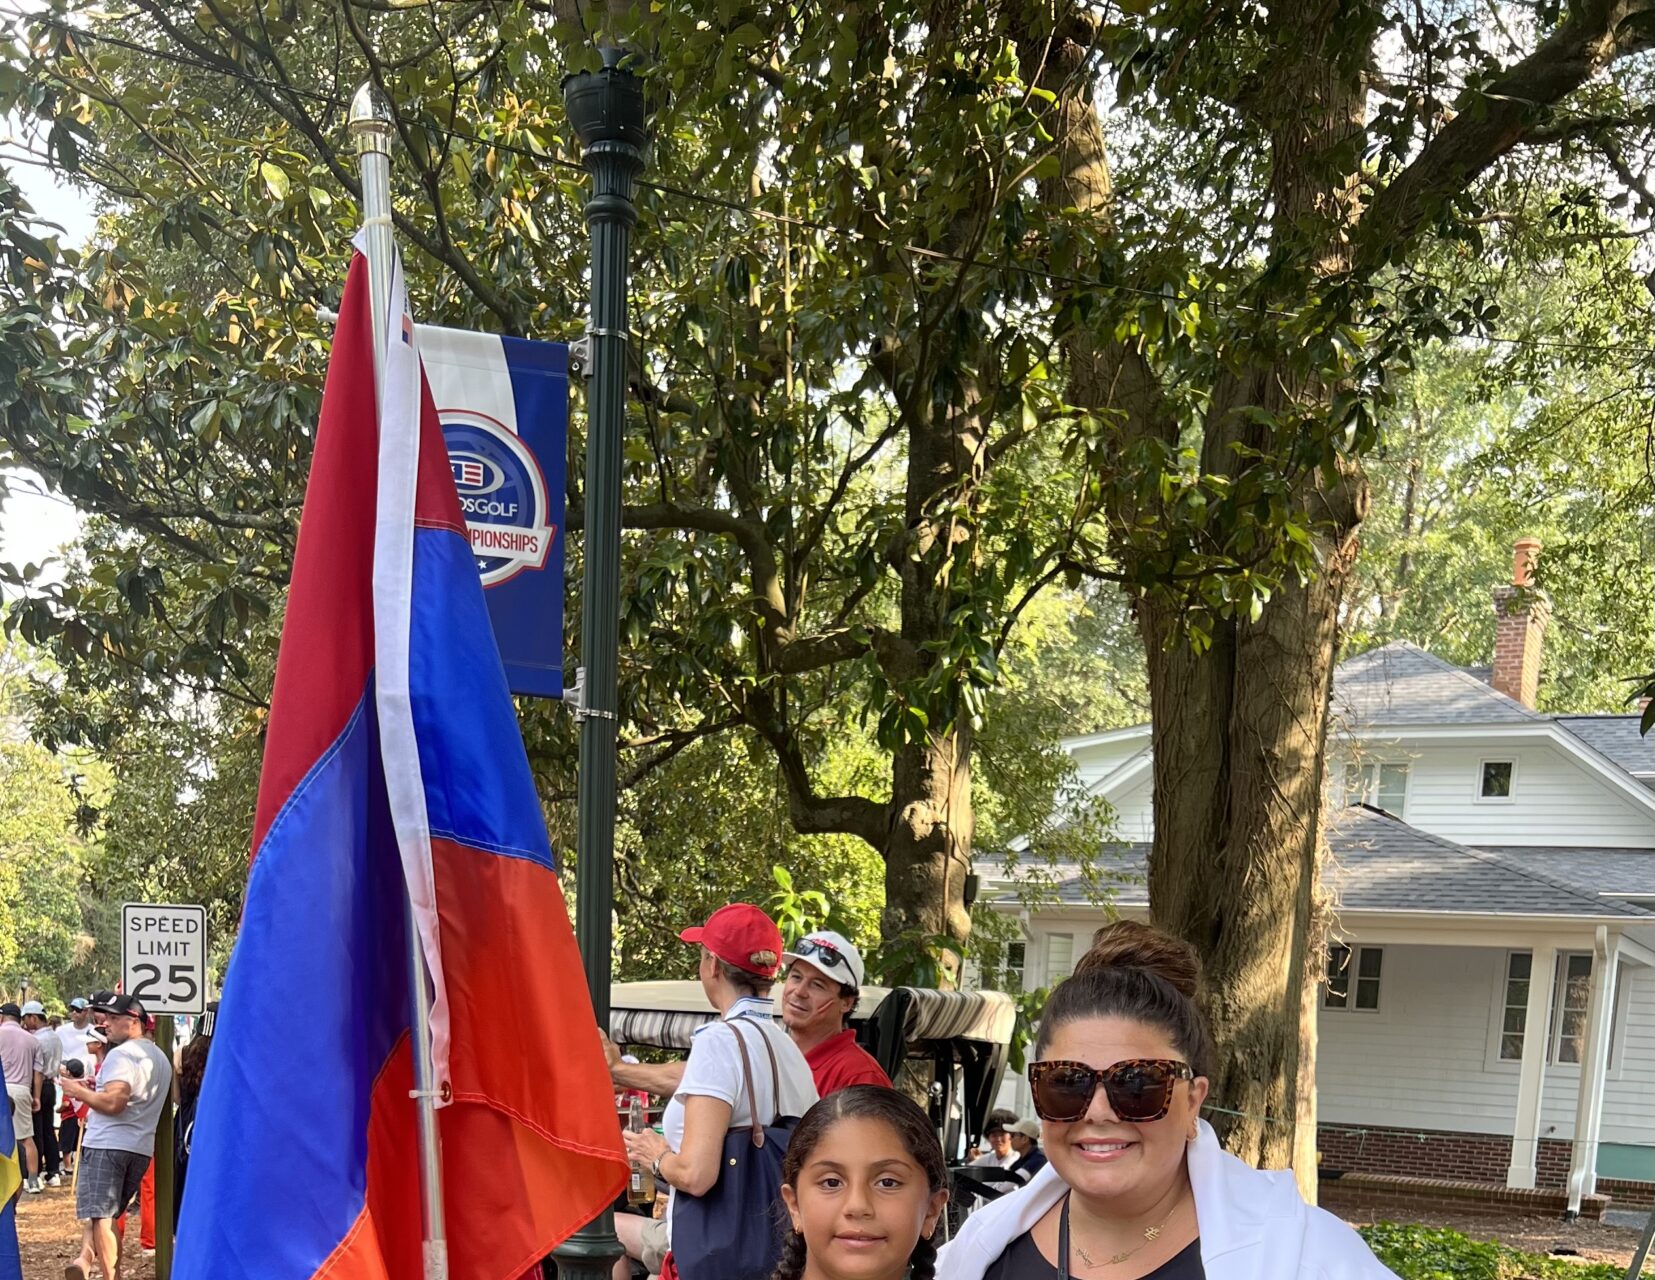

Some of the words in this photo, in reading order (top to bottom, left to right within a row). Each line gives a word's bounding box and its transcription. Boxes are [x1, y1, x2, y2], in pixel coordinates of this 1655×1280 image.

[130, 917, 198, 934] SPEED
[138, 940, 190, 956] LIMIT
[131, 963, 197, 1003] 25
